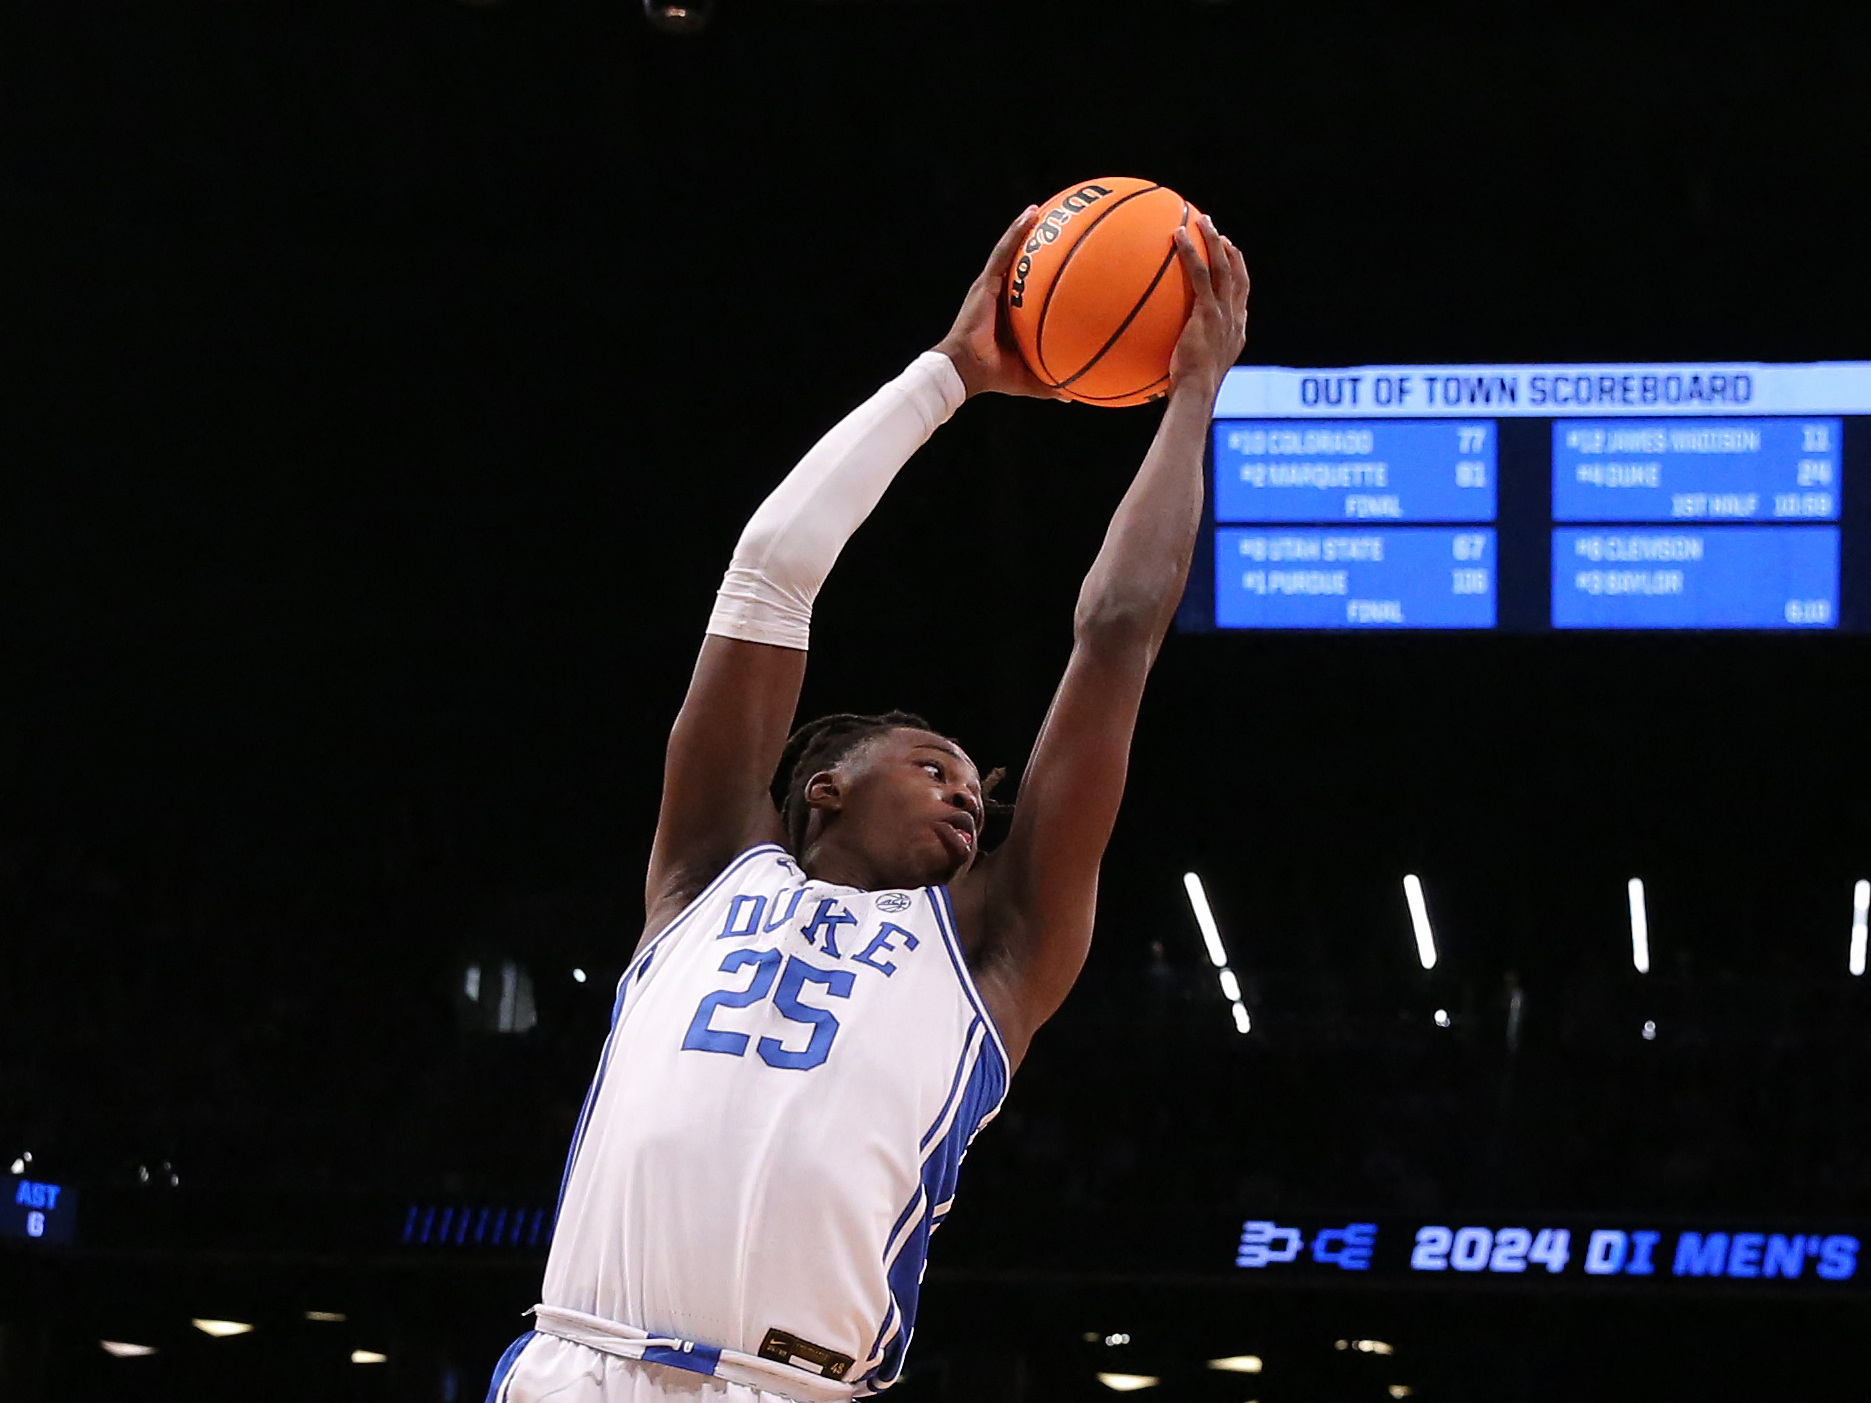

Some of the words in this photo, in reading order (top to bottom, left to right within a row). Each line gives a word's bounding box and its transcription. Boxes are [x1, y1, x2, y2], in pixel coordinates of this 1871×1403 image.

[1010, 185, 1113, 308] Wilson
[1301, 377, 1361, 406] OUT
[1373, 377, 1412, 405] OF
[1423, 376, 1518, 406] TOWN
[1529, 374, 1753, 405] SCOREBOARD
[1268, 430, 1373, 455] COLORADO
[1457, 426, 1487, 454] 77
[1268, 463, 1388, 489] MARQUETTE
[1606, 463, 1661, 487] DUKE
[1345, 494, 1403, 518] FINAL
[1322, 537, 1384, 562] STATE
[1604, 536, 1704, 561] CLEMSON
[1267, 570, 1349, 595] PURDUE
[1604, 570, 1683, 595] BAYLOR
[1346, 599, 1404, 623] FINAL
[716, 886, 921, 978] DUKE
[681, 947, 857, 1071] 25
[15, 1180, 62, 1211] AST
[1411, 1225, 1570, 1273] 2024
[1672, 1231, 1860, 1280] MEN'S
